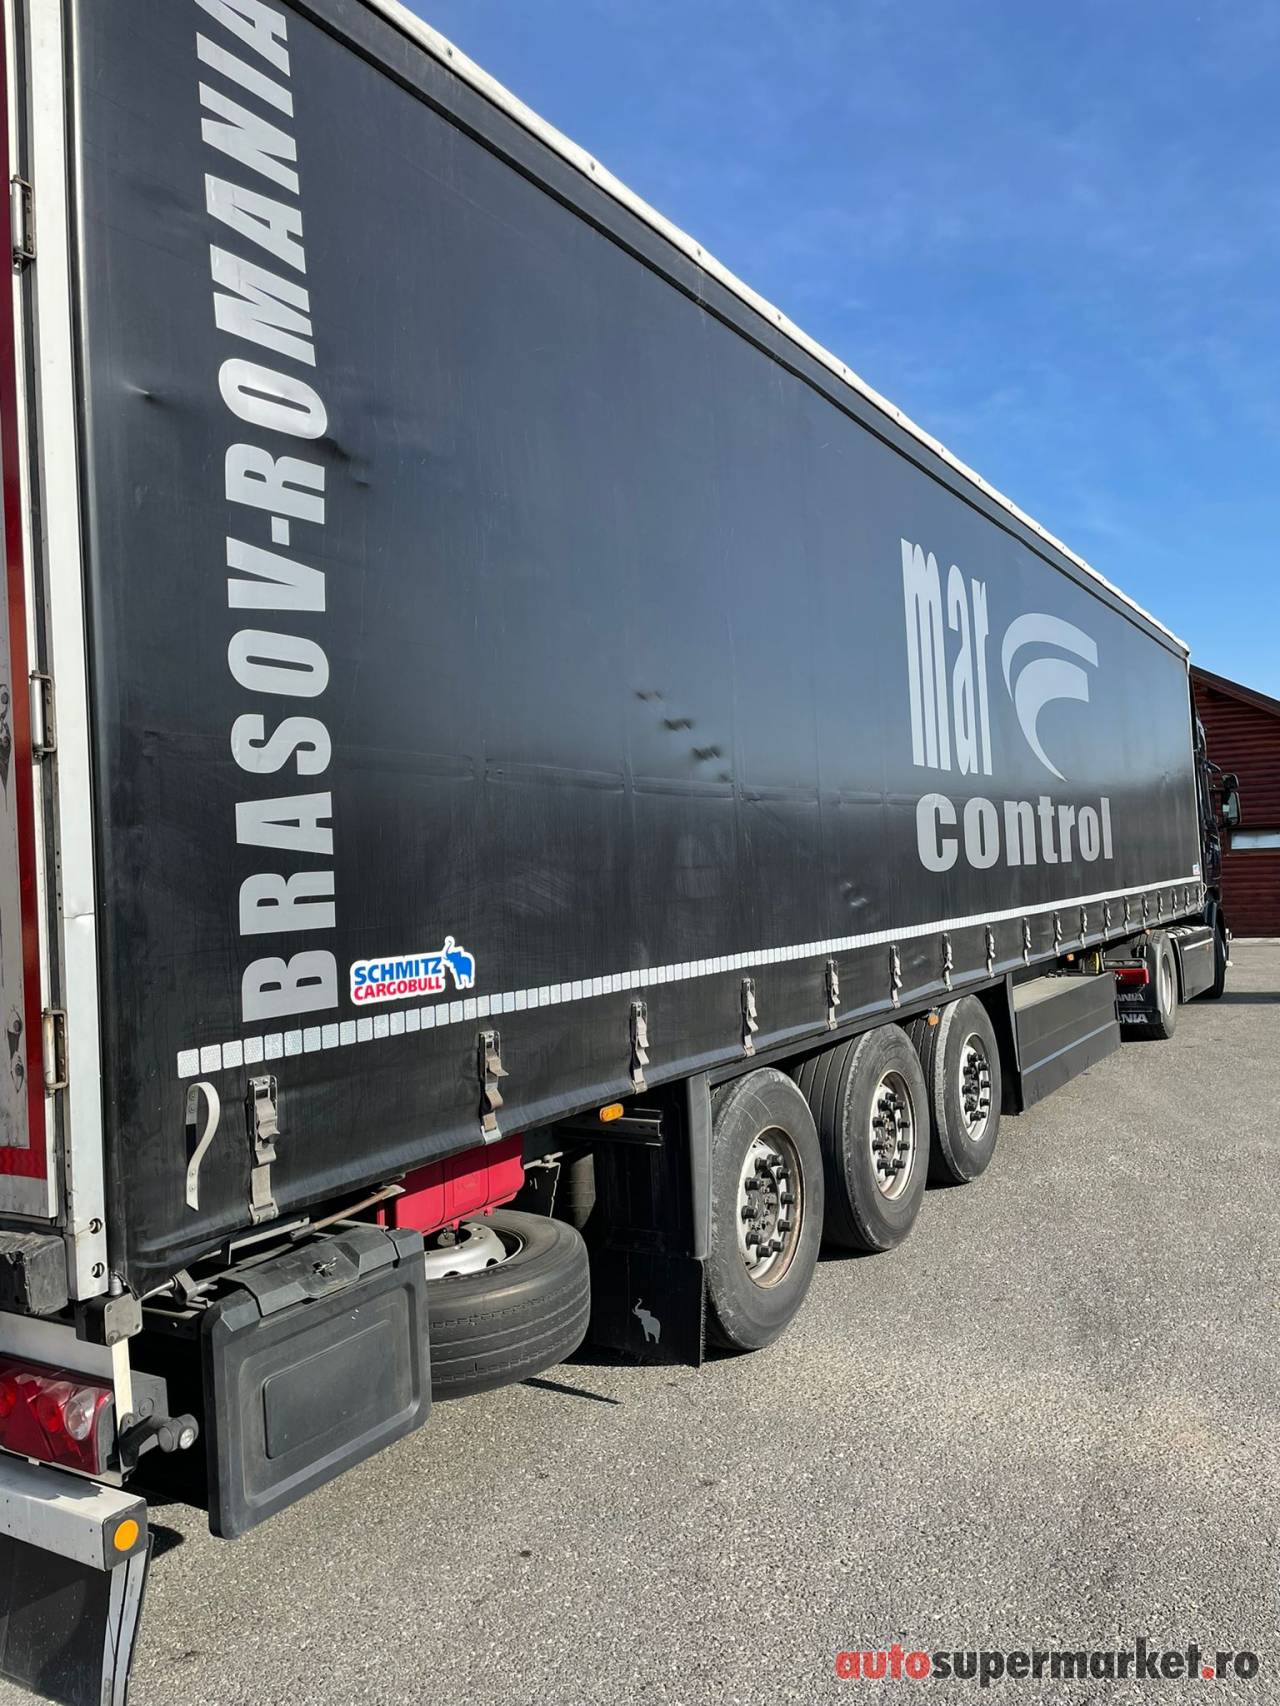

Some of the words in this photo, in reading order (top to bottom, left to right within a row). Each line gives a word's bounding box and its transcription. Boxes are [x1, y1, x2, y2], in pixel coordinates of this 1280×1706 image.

[193, 0, 339, 1022] BRASOV-ROMANIA
[901, 538, 992, 775] mar
[916, 793, 1113, 872] control
[354, 957, 442, 985] SCHMITZ
[354, 976, 442, 1000] CARGOBULL
